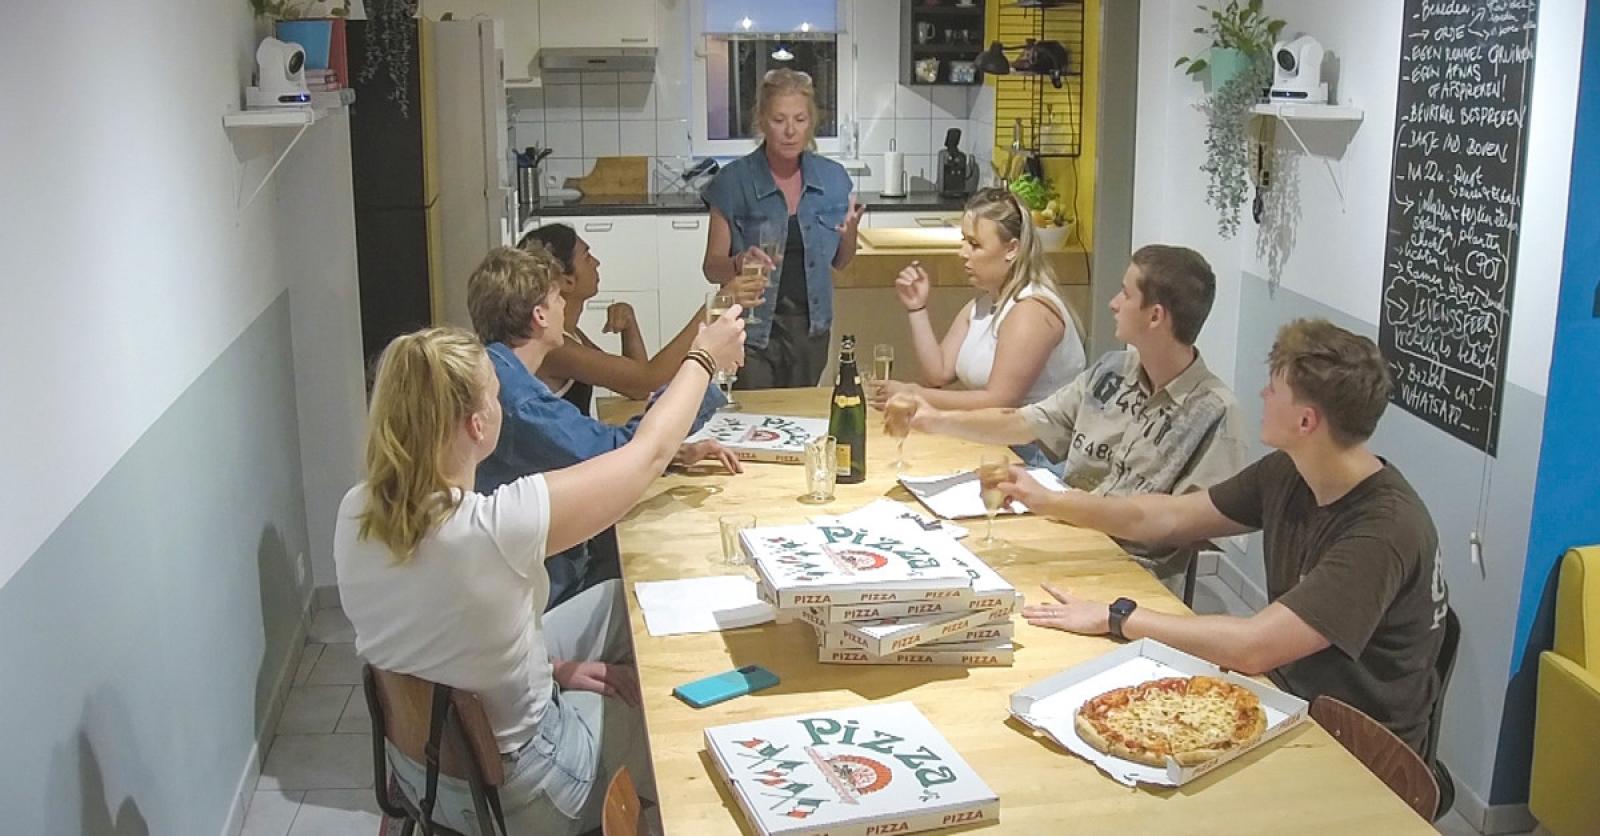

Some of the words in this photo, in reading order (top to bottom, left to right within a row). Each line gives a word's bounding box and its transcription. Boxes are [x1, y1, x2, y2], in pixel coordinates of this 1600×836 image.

[794, 595, 832, 605] PIZZA
[860, 592, 897, 602] PIZZA
[925, 590, 961, 599] PIZZA
[843, 608, 880, 620] PIZZA
[907, 603, 942, 615] PIZZA
[968, 599, 1002, 609] PIZZA
[843, 630, 869, 649] PIZZA
[891, 635, 921, 650] PIZZA
[942, 620, 969, 635] PIZZA
[966, 630, 1001, 640] PIZZA
[832, 652, 868, 662] PIZZA
[896, 654, 933, 664] PIZZA
[961, 655, 998, 665] PIZZA
[866, 821, 909, 836] PIZZA
[942, 809, 984, 825] PIZZA
